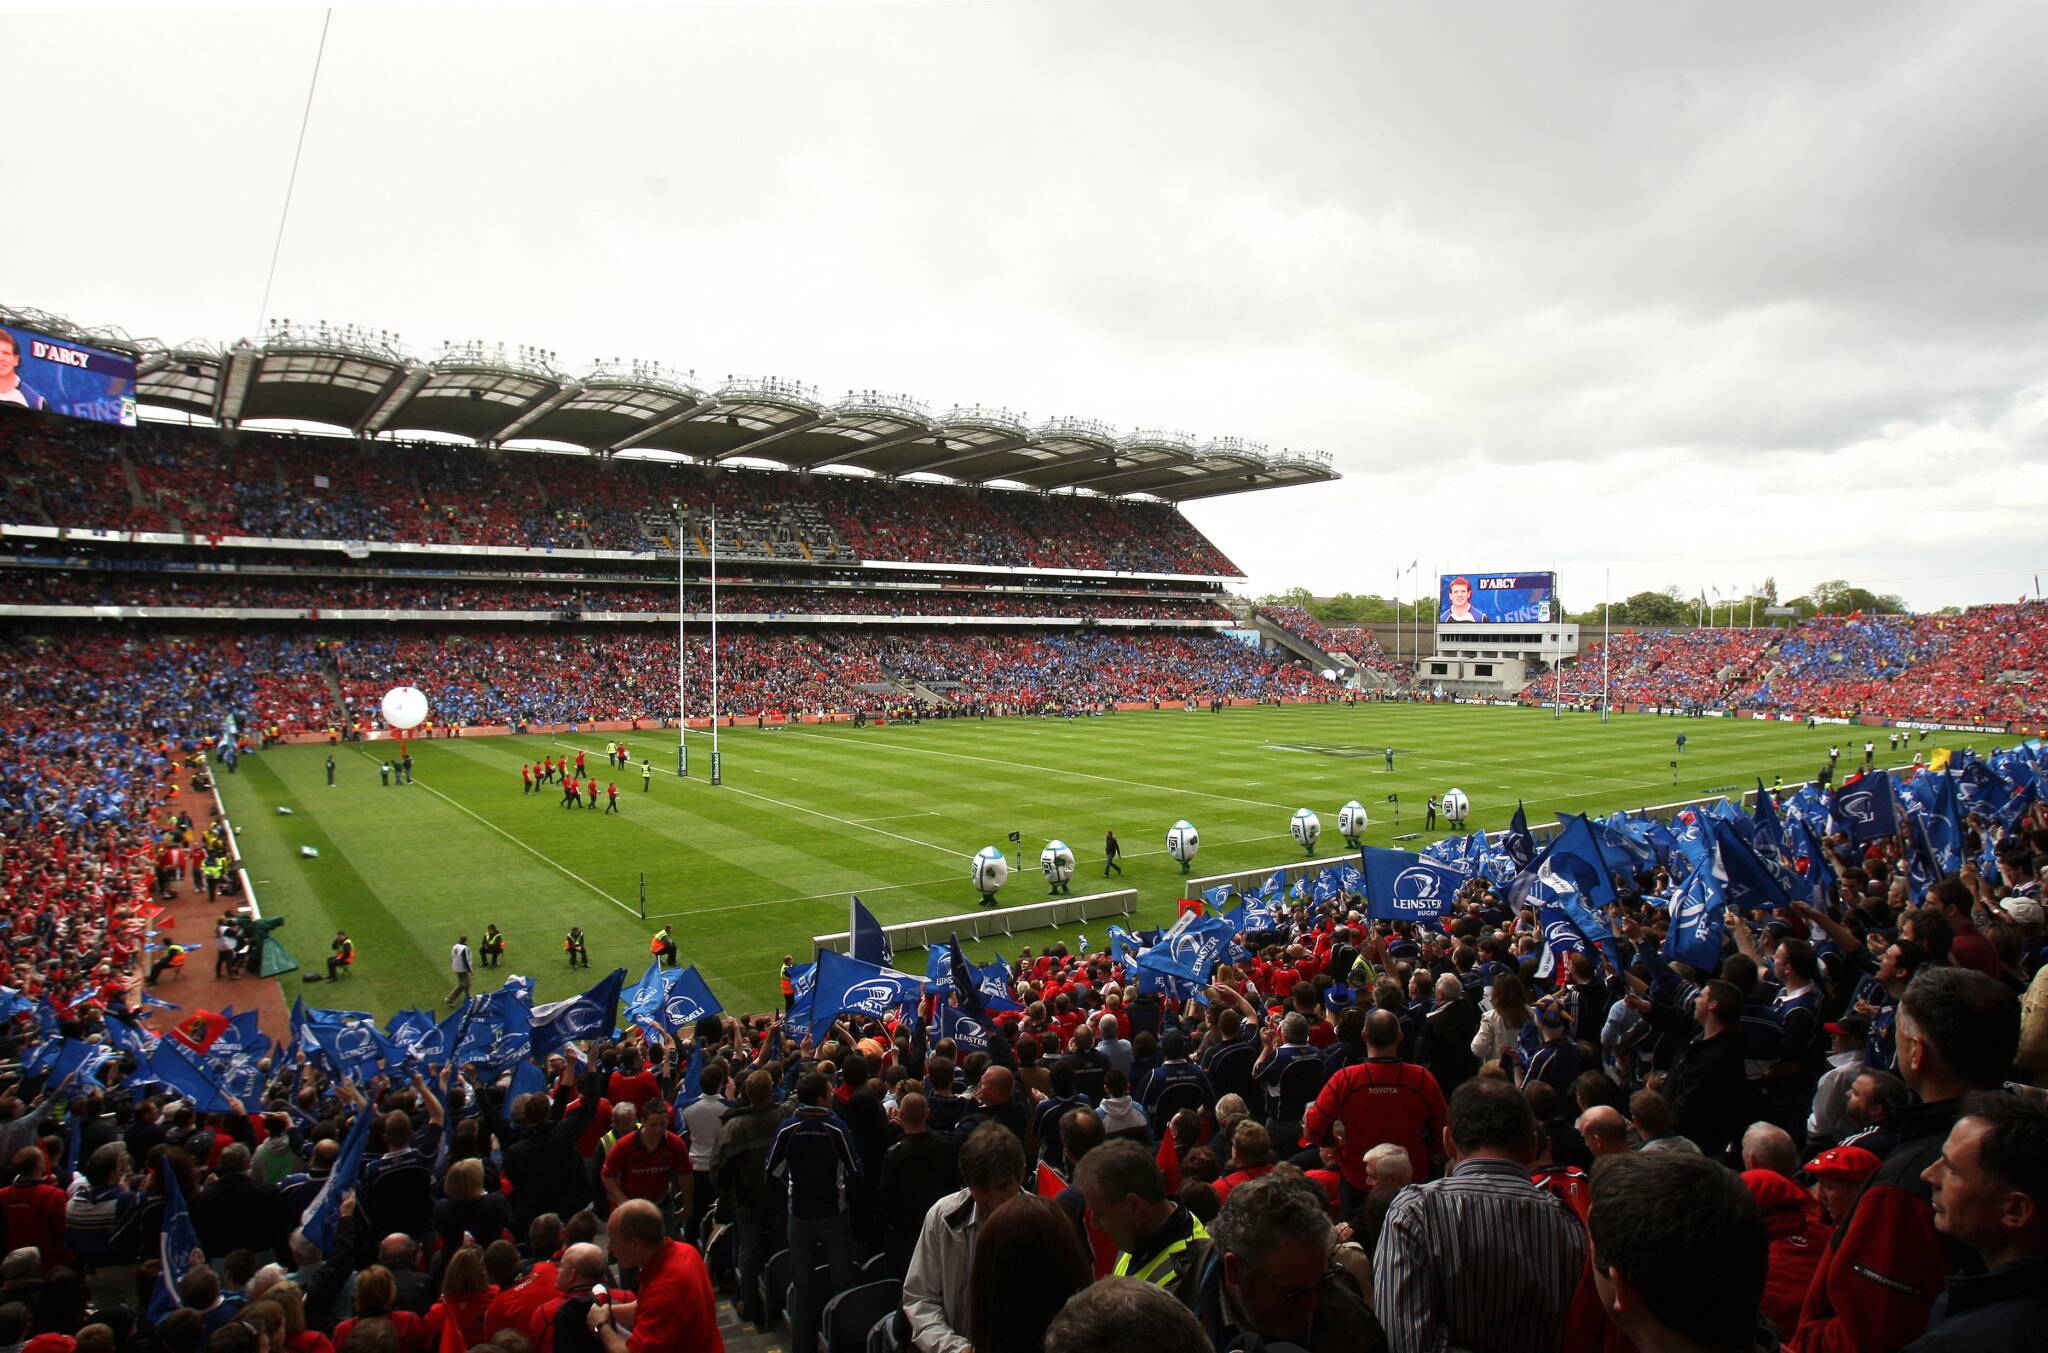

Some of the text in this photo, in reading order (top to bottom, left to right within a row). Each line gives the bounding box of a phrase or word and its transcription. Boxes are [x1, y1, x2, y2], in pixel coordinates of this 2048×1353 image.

[31, 340, 90, 368] D'ARCY
[1479, 577, 1517, 589] D'ARCY
[1393, 898, 1442, 910] LEINSTER
[1191, 936, 1220, 976] LEINSTER
[1368, 1087, 1399, 1095] TOYOTA
